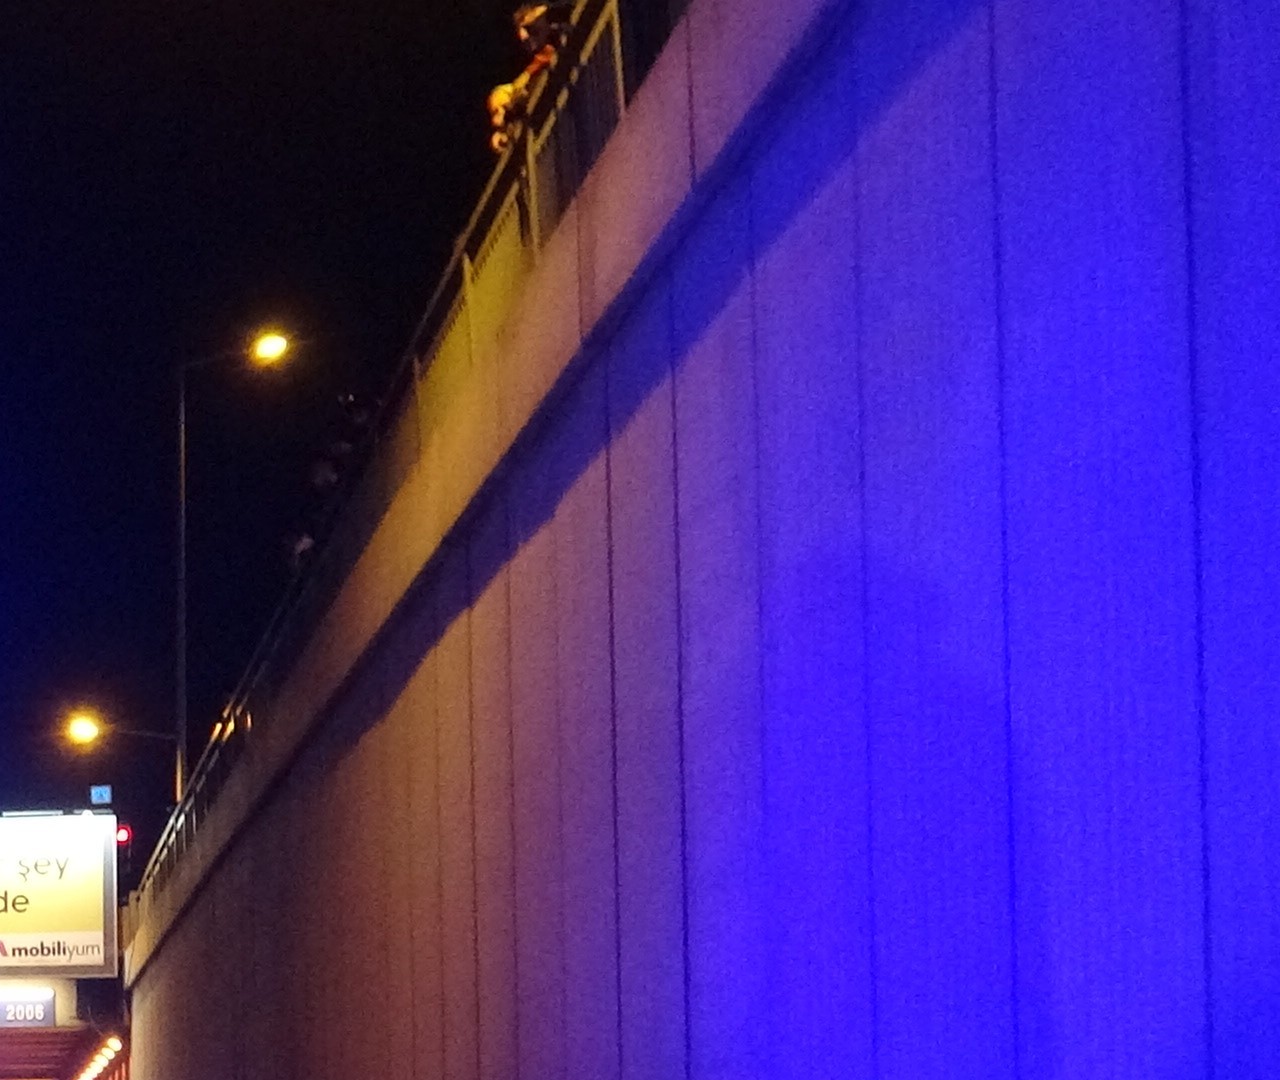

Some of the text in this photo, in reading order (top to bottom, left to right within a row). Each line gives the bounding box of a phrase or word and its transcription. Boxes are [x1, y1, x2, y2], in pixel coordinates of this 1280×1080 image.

[18, 856, 69, 881] şey
[11, 940, 101, 960] mobiliyum
[5, 1004, 44, 1021] 2006
